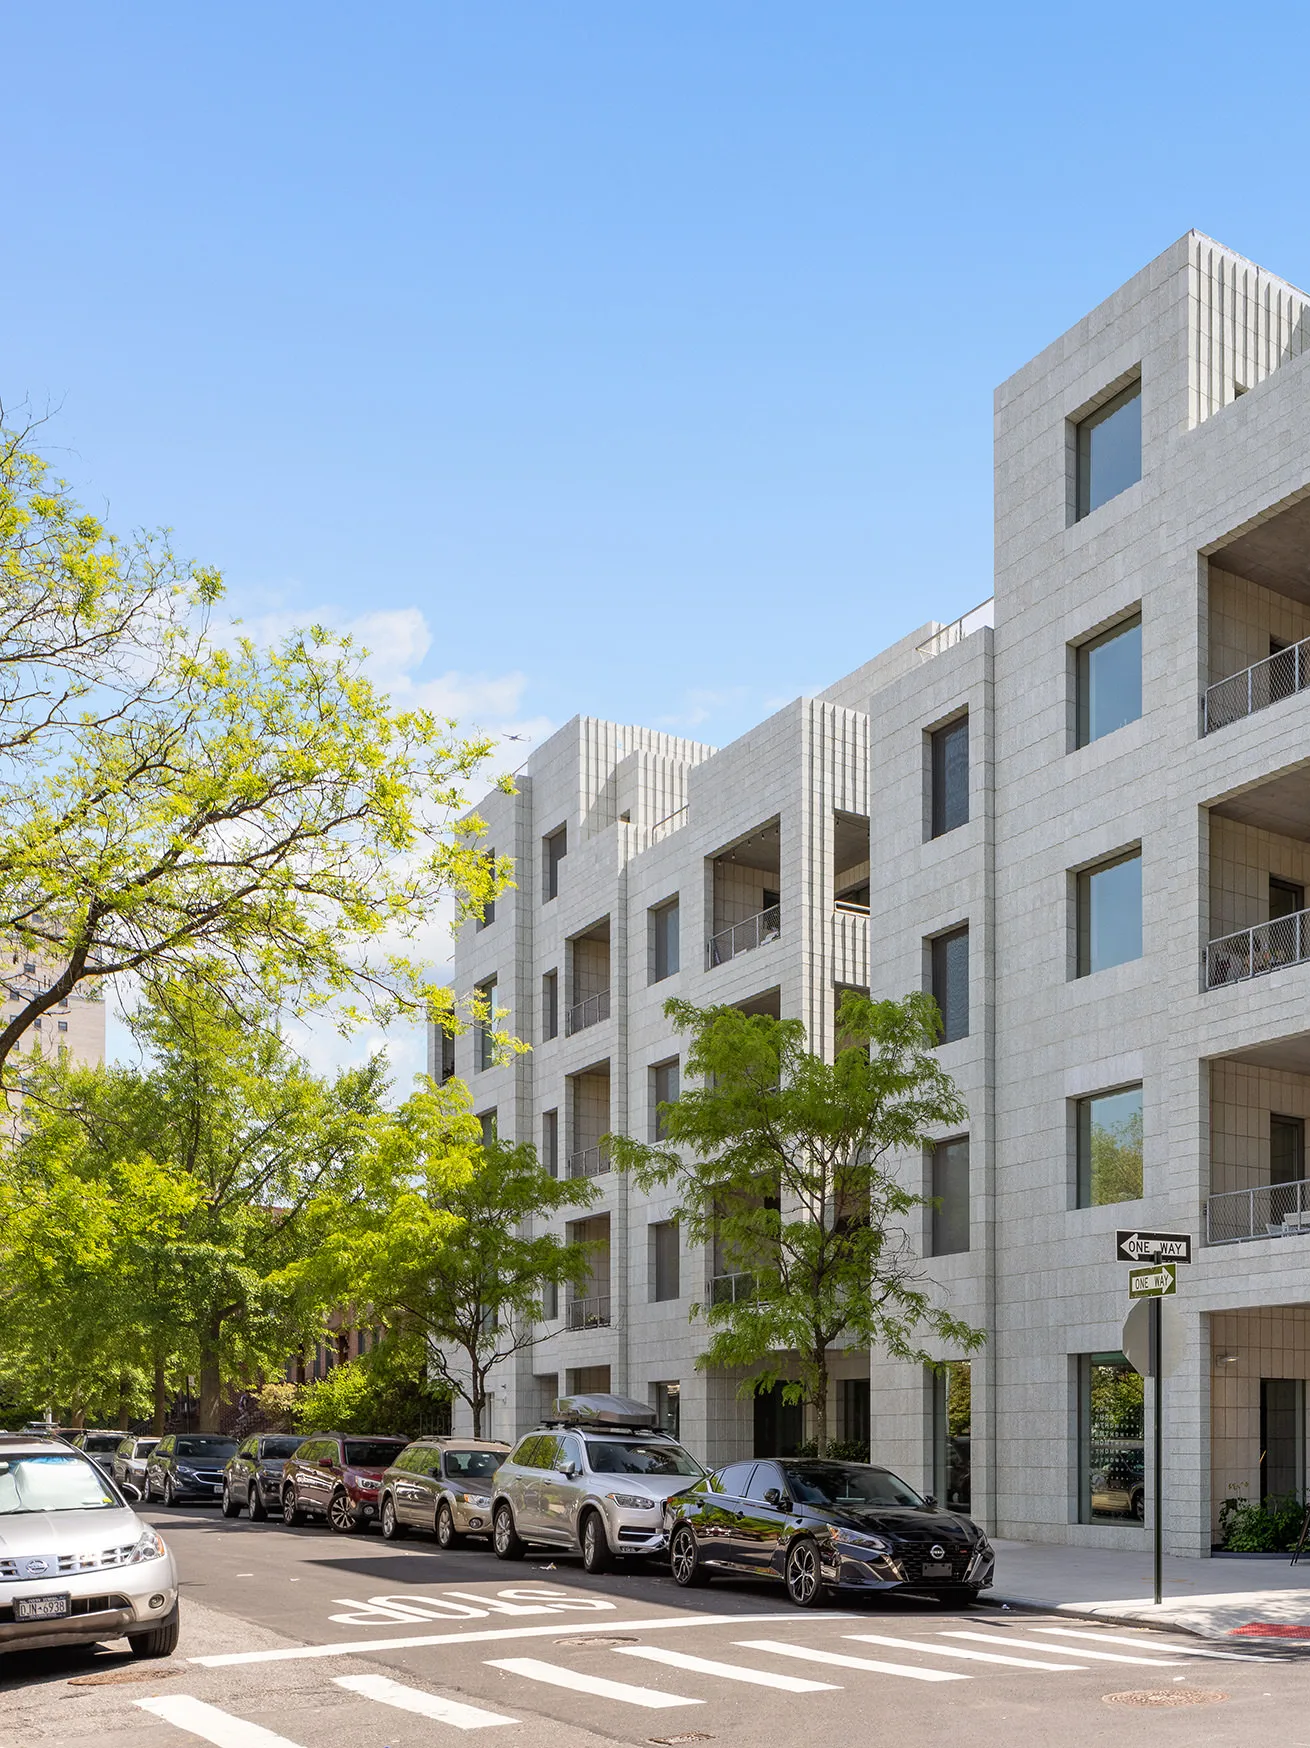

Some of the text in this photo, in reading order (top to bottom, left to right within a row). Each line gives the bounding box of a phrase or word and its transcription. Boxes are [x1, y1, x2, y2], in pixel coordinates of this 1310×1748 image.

[1128, 1241, 1182, 1254] ONE WAY
[1135, 1274, 1169, 1290] ONE WAY
[328, 1589, 617, 1625] STOP
